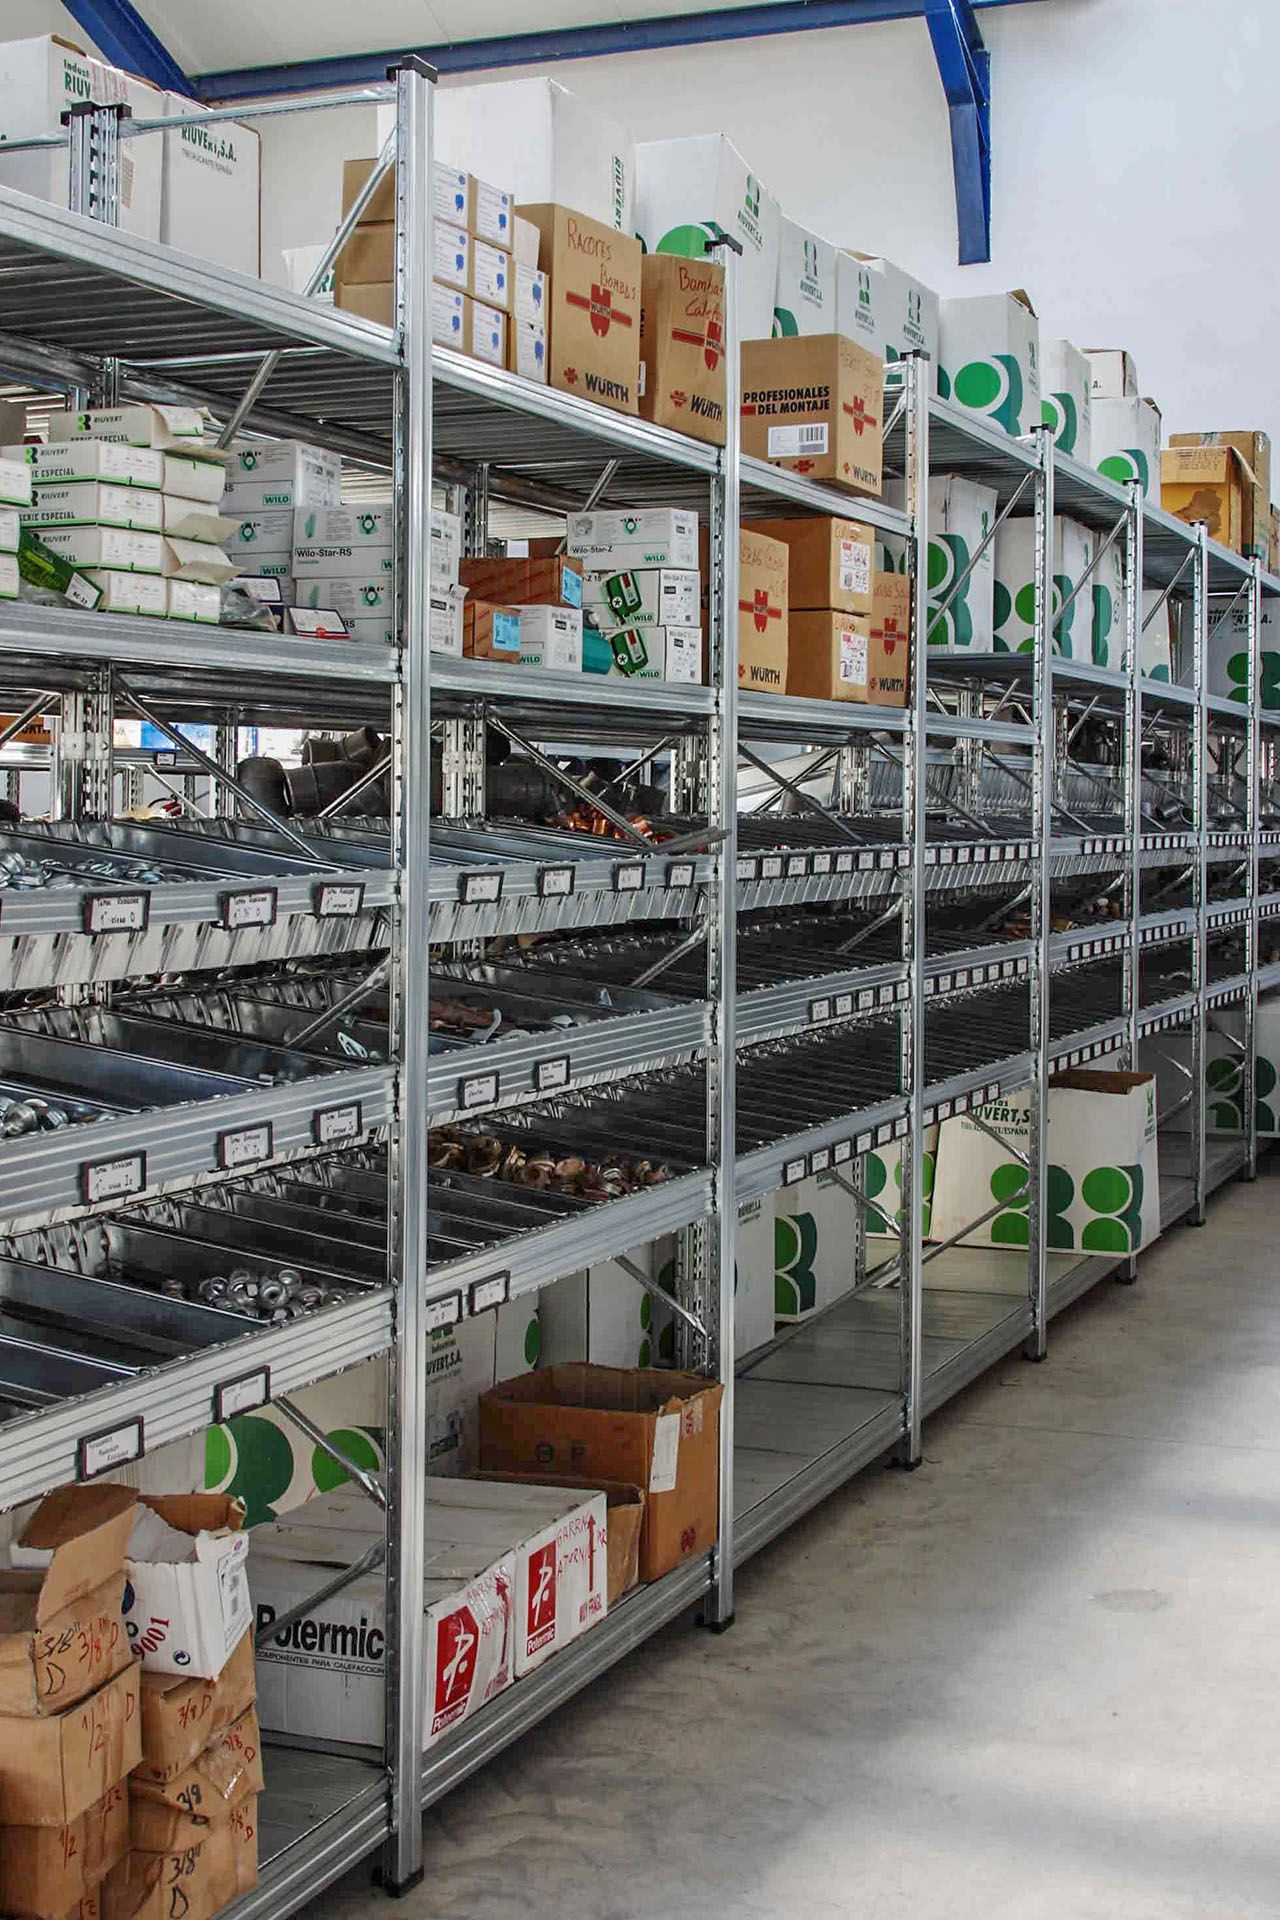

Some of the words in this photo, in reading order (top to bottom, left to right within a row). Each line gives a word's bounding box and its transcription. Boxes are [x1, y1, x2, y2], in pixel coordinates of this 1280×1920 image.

[64, 59, 89, 77] Indust
[64, 71, 91, 99] RIUV
[585, 372, 629, 403] WÜRTH
[743, 386, 830, 403] PROFESIONALES
[758, 403, 777, 415] DEL
[780, 399, 830, 414] MONTAJE
[42, 468, 75, 478] ESPECIAL
[264, 496, 289, 504] WILO
[42, 511, 75, 520] ESPECIAL
[297, 548, 352, 558] Wilo-Star-RS
[644, 554, 666, 562] WILO
[262, 567, 287, 575] WILO
[750, 666, 781, 684] WÜRTH
[130, 1617, 169, 1660] 9001
